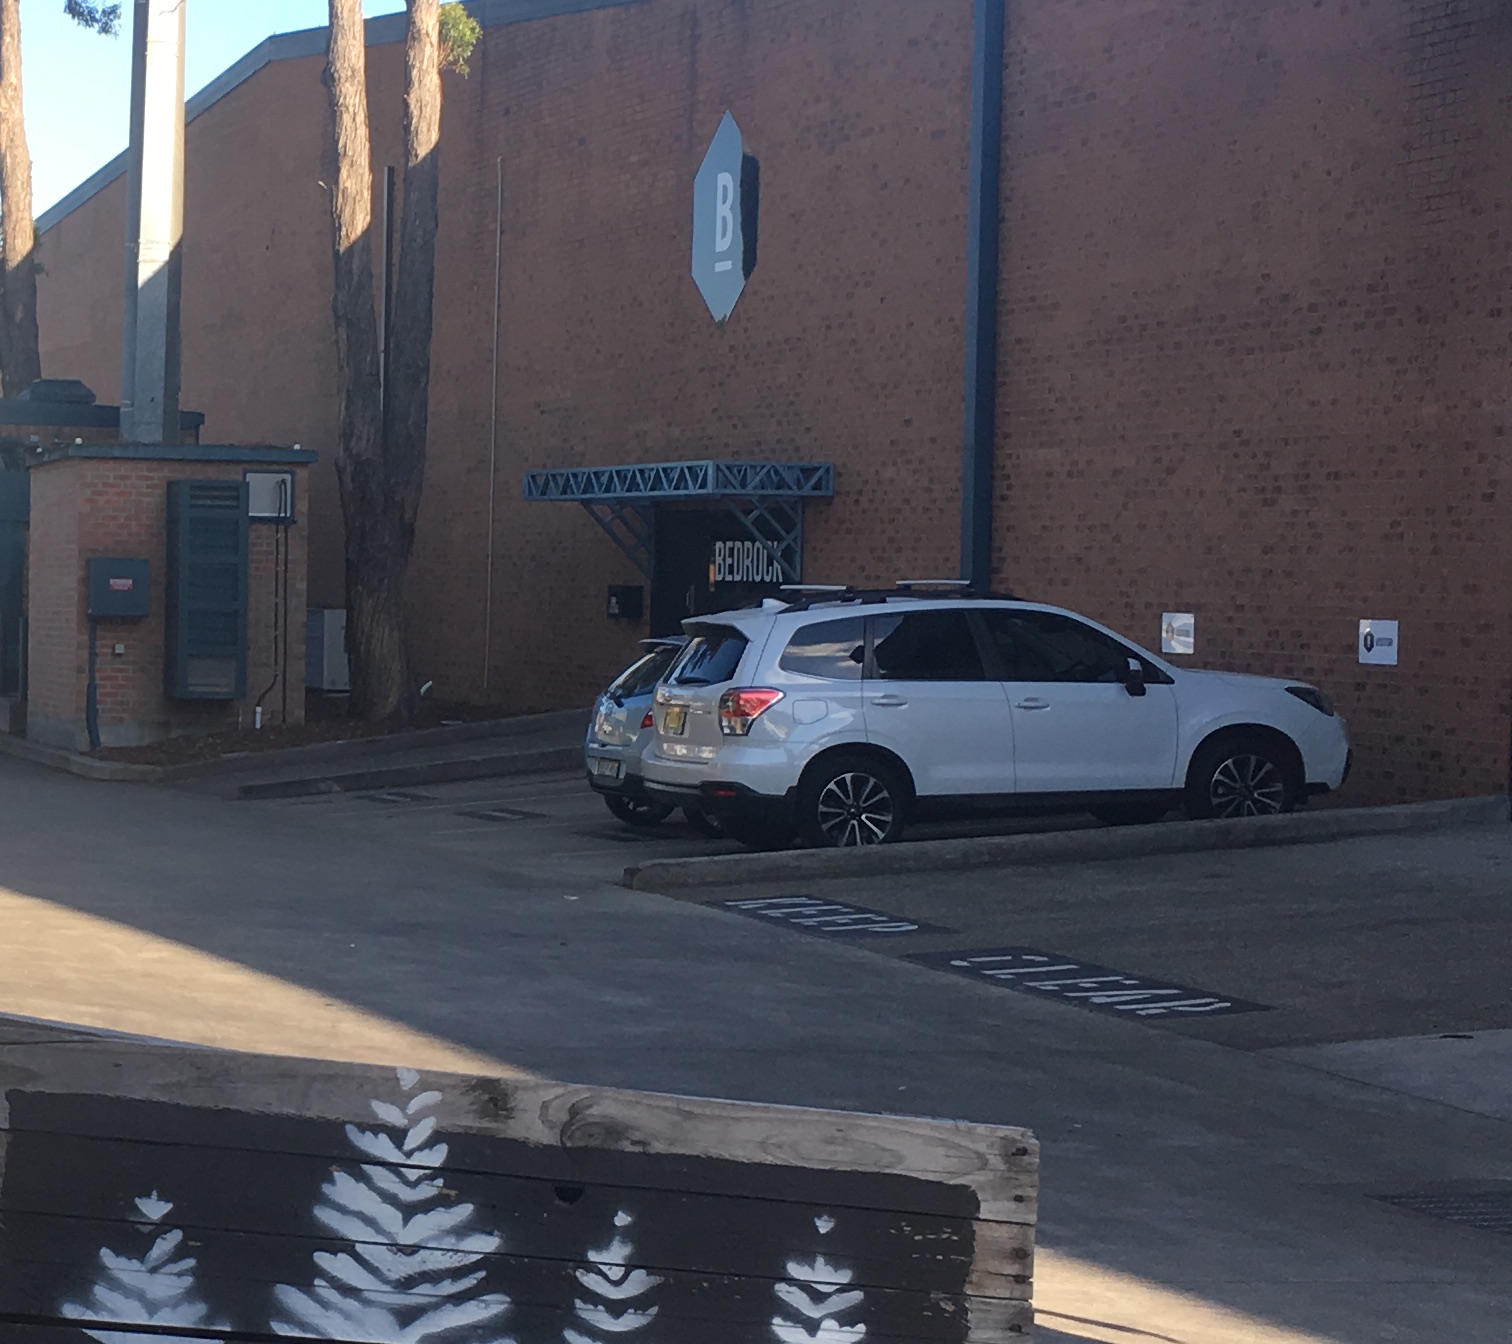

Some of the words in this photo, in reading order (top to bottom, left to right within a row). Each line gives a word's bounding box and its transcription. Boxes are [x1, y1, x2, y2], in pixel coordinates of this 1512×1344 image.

[715, 171, 734, 253] B
[715, 540, 784, 583] BEDROCK
[724, 896, 919, 932] KEEP
[949, 955, 1232, 1016] CLEAR
